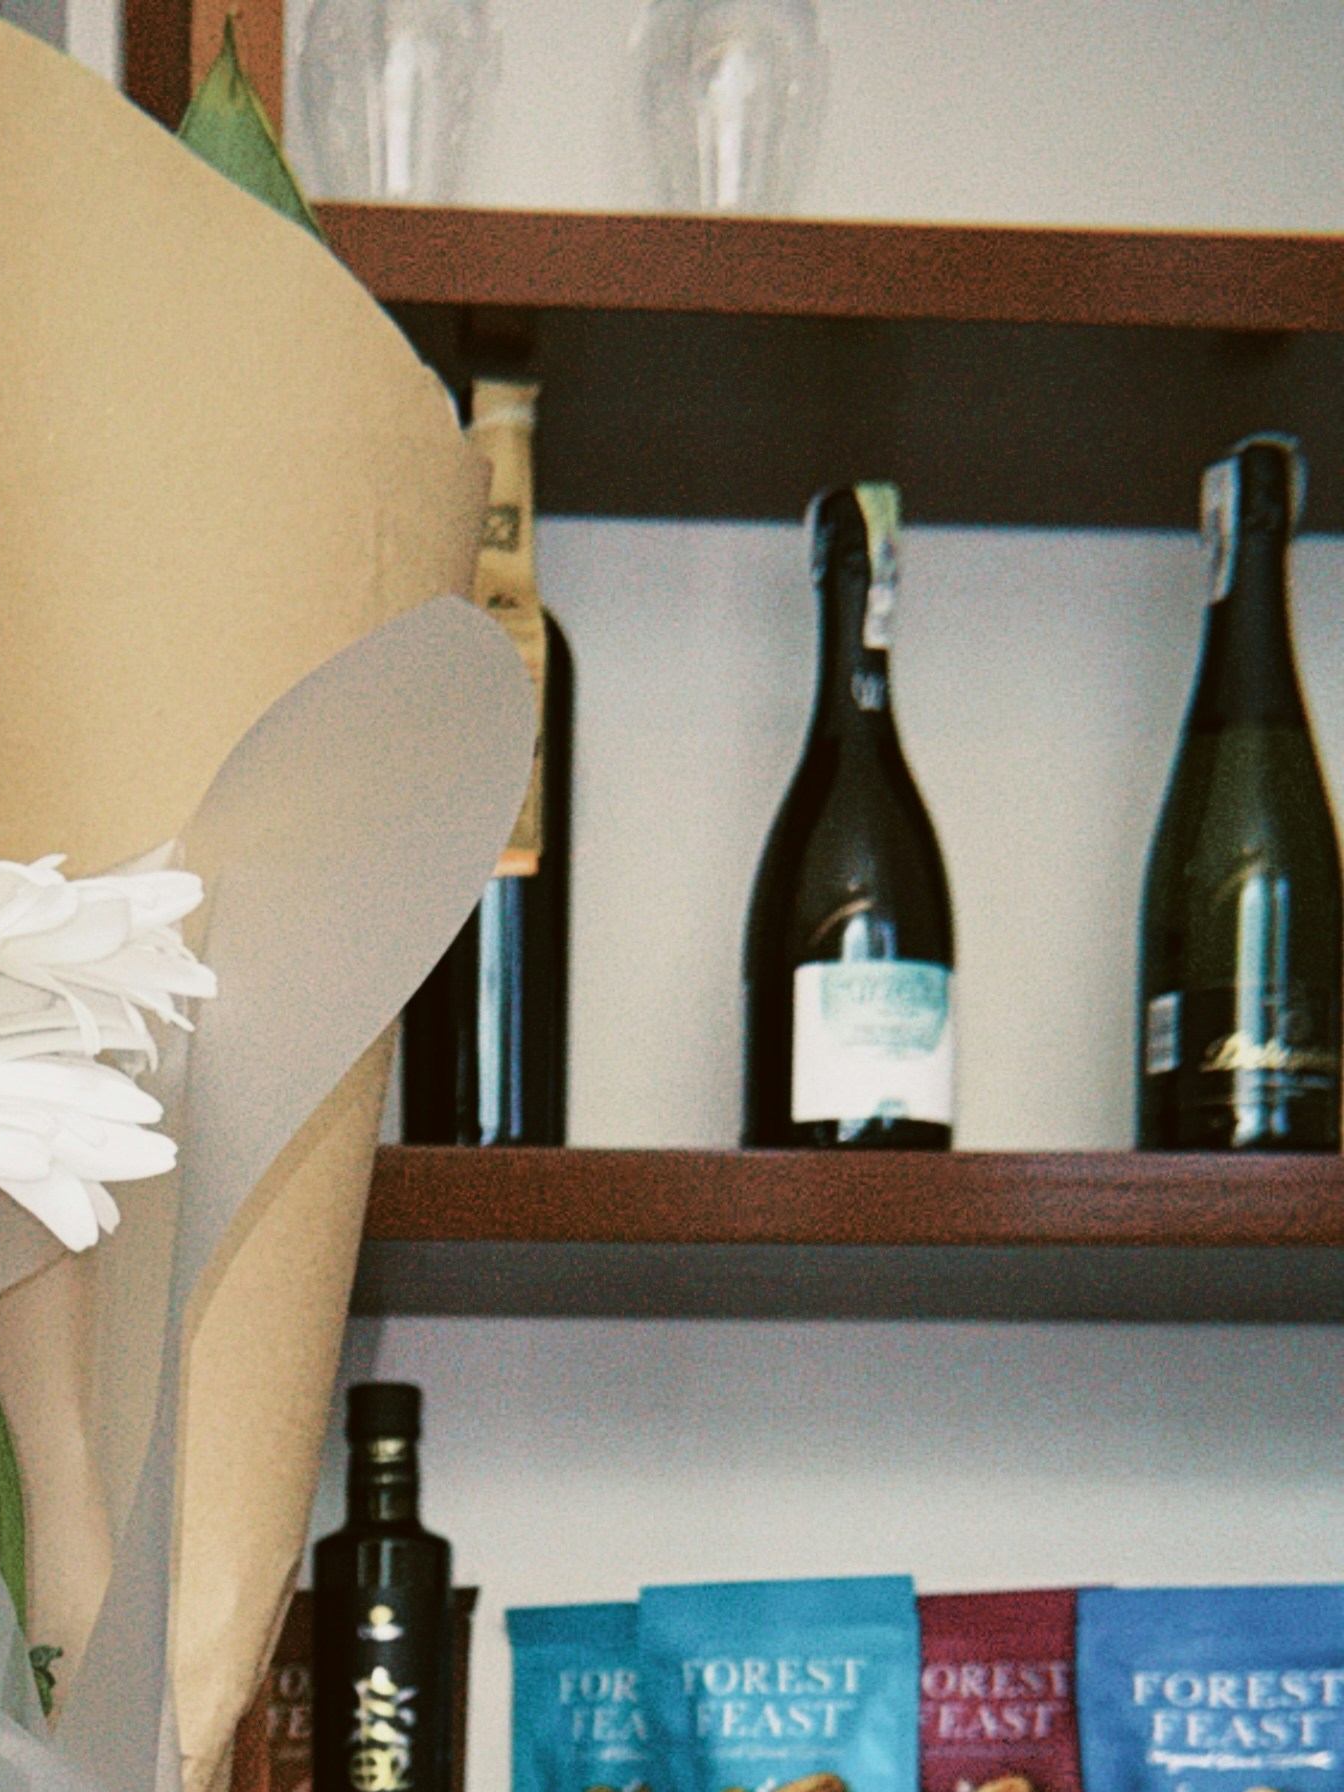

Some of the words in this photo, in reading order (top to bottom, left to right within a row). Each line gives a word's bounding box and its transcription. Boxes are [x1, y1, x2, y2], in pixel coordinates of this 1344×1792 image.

[558, 1668, 639, 1704] FOR
[683, 1657, 866, 1697] FOREST
[920, 1661, 1071, 1698] OREST
[1131, 1670, 1344, 1709] FOREST
[697, 1701, 853, 1738] FEAST
[1152, 1709, 1333, 1749] FEAST
